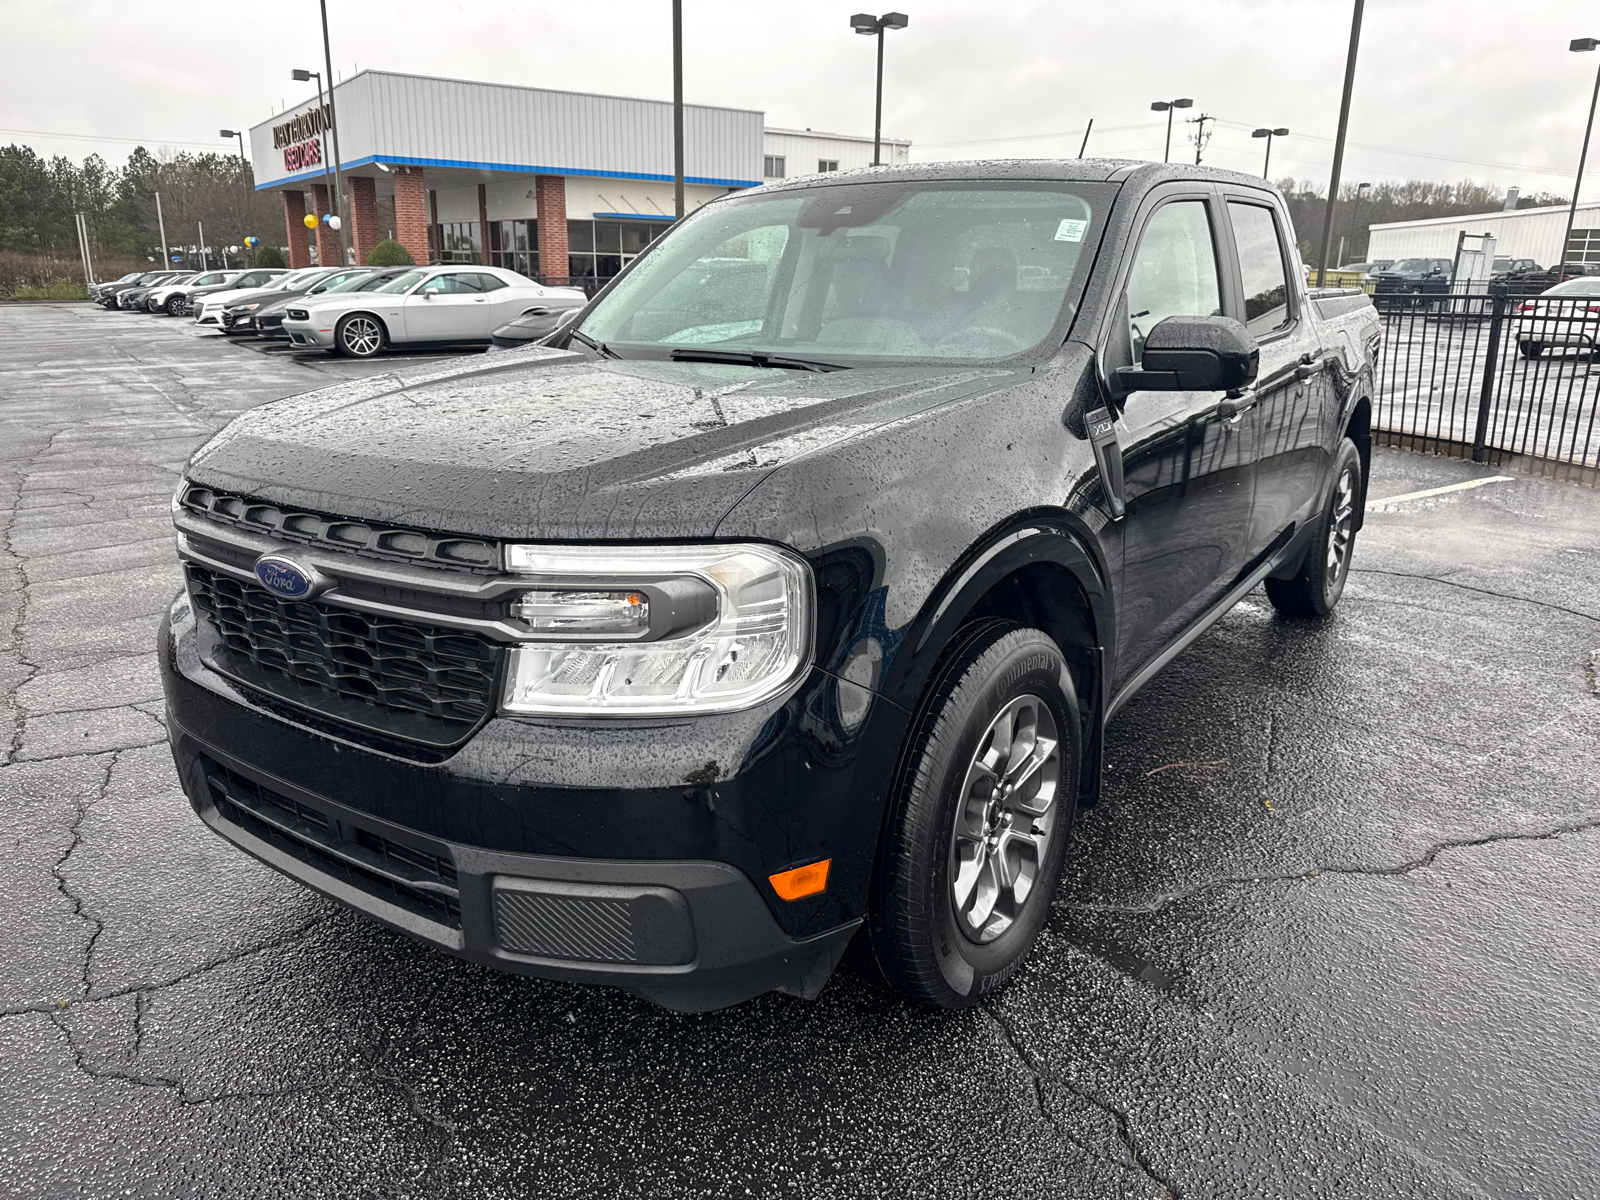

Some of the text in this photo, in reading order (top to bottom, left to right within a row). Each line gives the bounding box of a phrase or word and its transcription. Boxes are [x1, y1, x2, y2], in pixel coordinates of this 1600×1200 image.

[272, 103, 332, 149] JOHN THORNTON
[283, 138, 321, 171] USED CARS
[1093, 421, 1112, 436] XLT
[264, 564, 296, 591] Ford
[996, 652, 1049, 699] Continental
